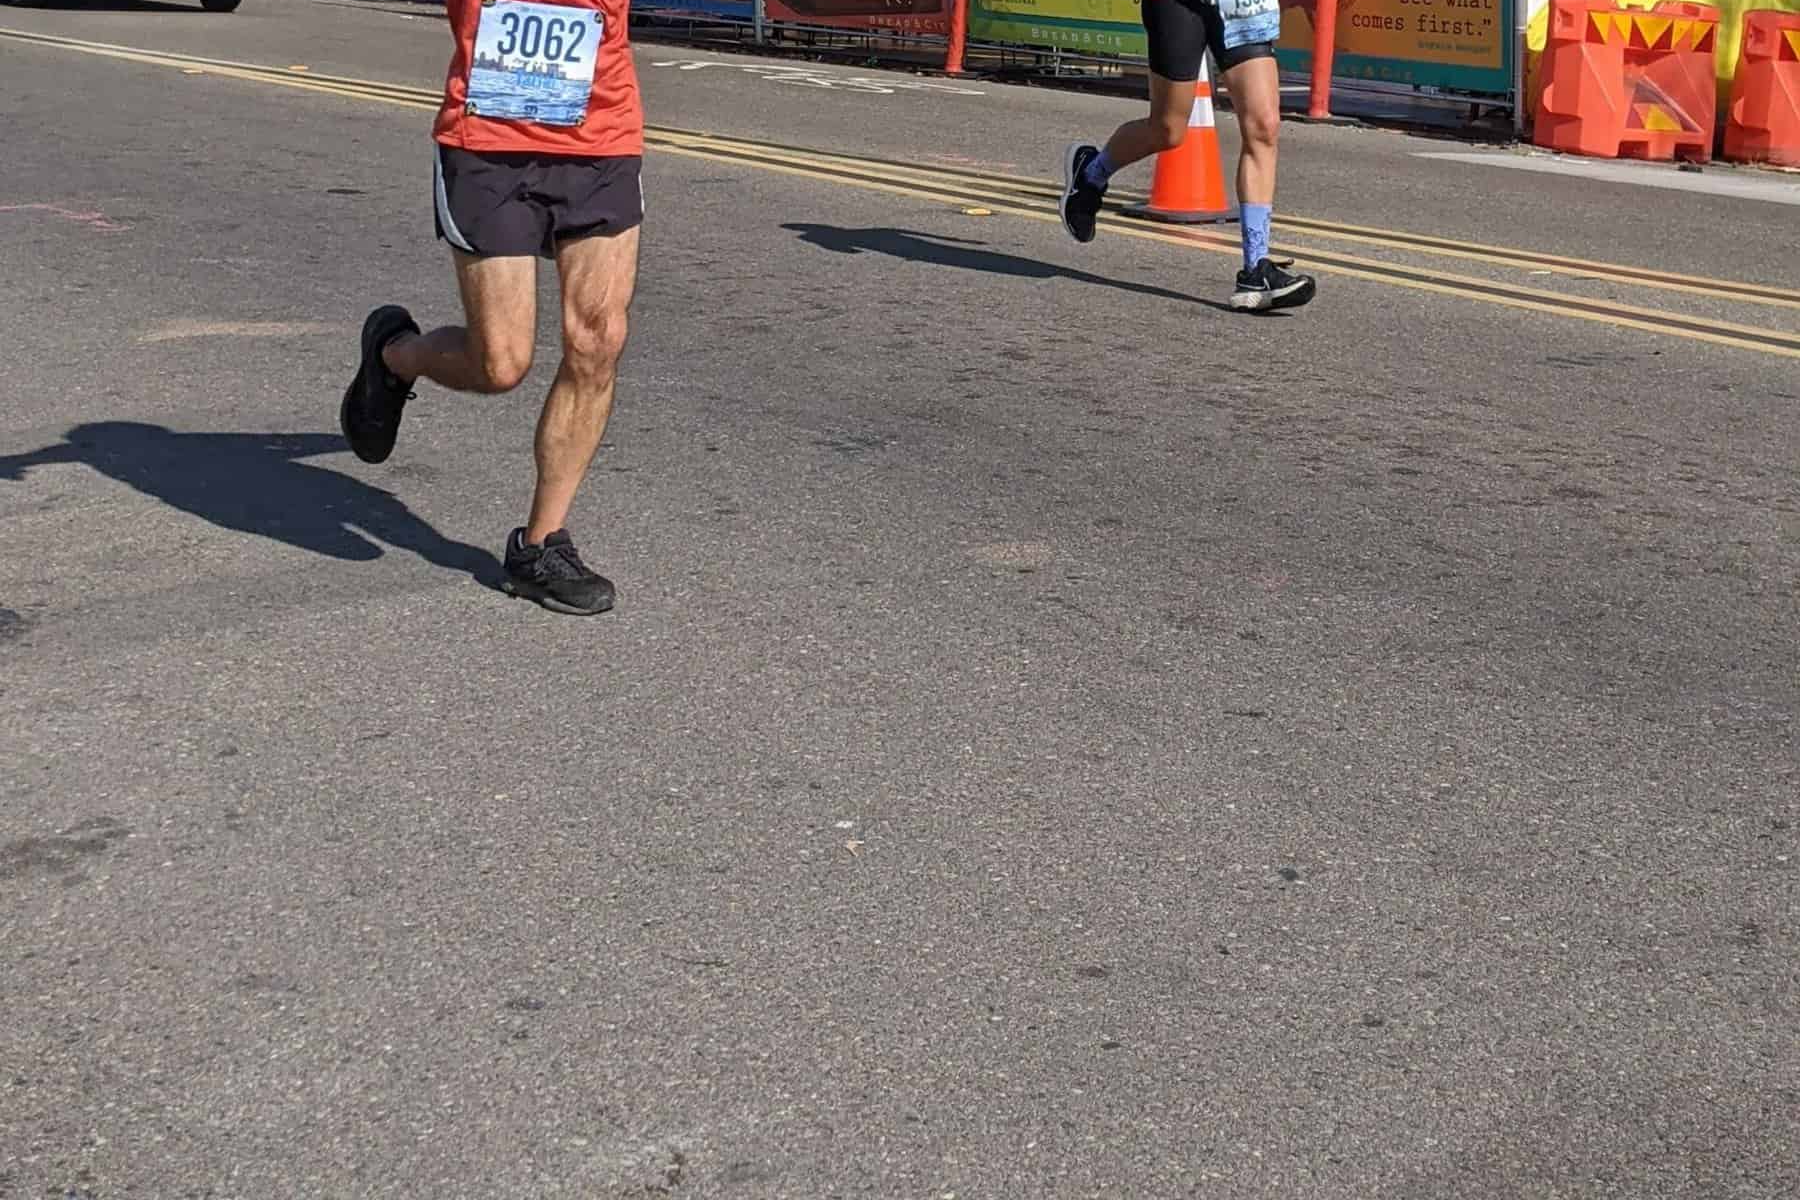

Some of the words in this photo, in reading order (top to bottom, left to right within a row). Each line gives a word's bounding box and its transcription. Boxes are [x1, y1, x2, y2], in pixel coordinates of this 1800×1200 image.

[496, 11, 587, 63] 3062
[1351, 12, 1405, 32] comes
[1416, 13, 1492, 37] first."
